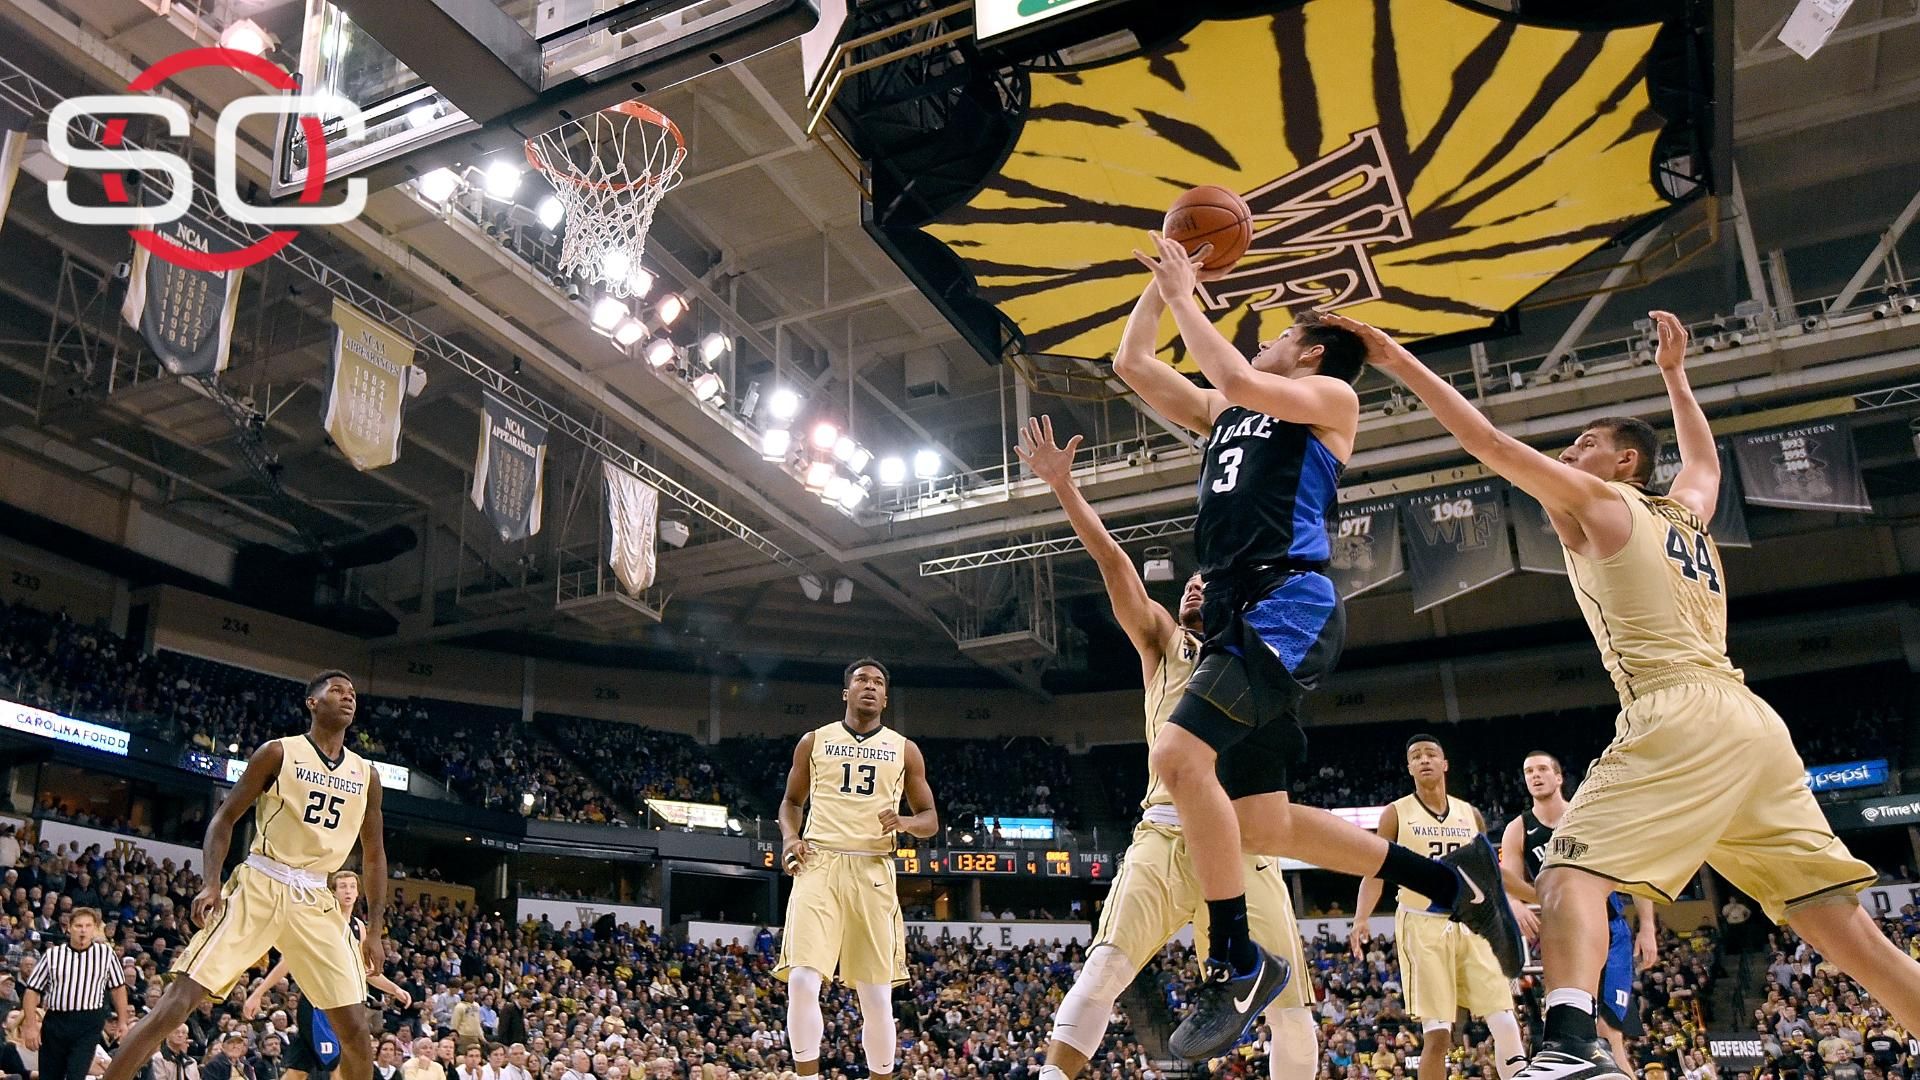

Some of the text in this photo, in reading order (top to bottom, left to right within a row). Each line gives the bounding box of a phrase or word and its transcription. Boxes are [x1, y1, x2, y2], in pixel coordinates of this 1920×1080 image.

[175, 221, 209, 254] NCAA
[362, 330, 386, 355] NCAA
[345, 337, 399, 377] APPEARANCES
[505, 416, 526, 440] NCAA
[1747, 424, 1835, 445] SWEET SIXTEEN
[491, 425, 536, 458] APPEARANCES
[1211, 446, 1244, 494] 3
[1410, 485, 1491, 506] FINAL FOUR
[1360, 502, 1395, 515] FINALS
[1431, 499, 1474, 522] 1962
[1338, 515, 1371, 538] 977
[1408, 501, 1499, 552] WF
[1664, 525, 1721, 595] 44
[222, 616, 249, 635] 234
[83, 730, 116, 747] FORD
[824, 744, 897, 762] WAKE FOREST
[295, 767, 364, 795] WAKE FOREST
[840, 763, 876, 796] 13
[1815, 765, 1869, 788] pepsi
[303, 790, 346, 830] 25
[1878, 806, 1911, 818] Time
[1412, 826, 1471, 838] WAKE FOREST
[757, 842, 773, 851] PLR
[1553, 836, 1589, 861] WF
[764, 852, 774, 867] 2
[904, 859, 918, 873] 13
[930, 860, 939, 873] 4
[958, 854, 997, 871] 13:22
[1007, 859, 1013, 872] 1
[1080, 854, 1108, 863] TM FLS
[1027, 862, 1037, 875] 4
[1056, 862, 1071, 877] 14
[1091, 863, 1102, 878] 2
[907, 925, 1013, 947] WAKE
[1616, 989, 1629, 1008] D
[320, 1041, 333, 1055] D
[1710, 1040, 1763, 1057] DEFENSE
